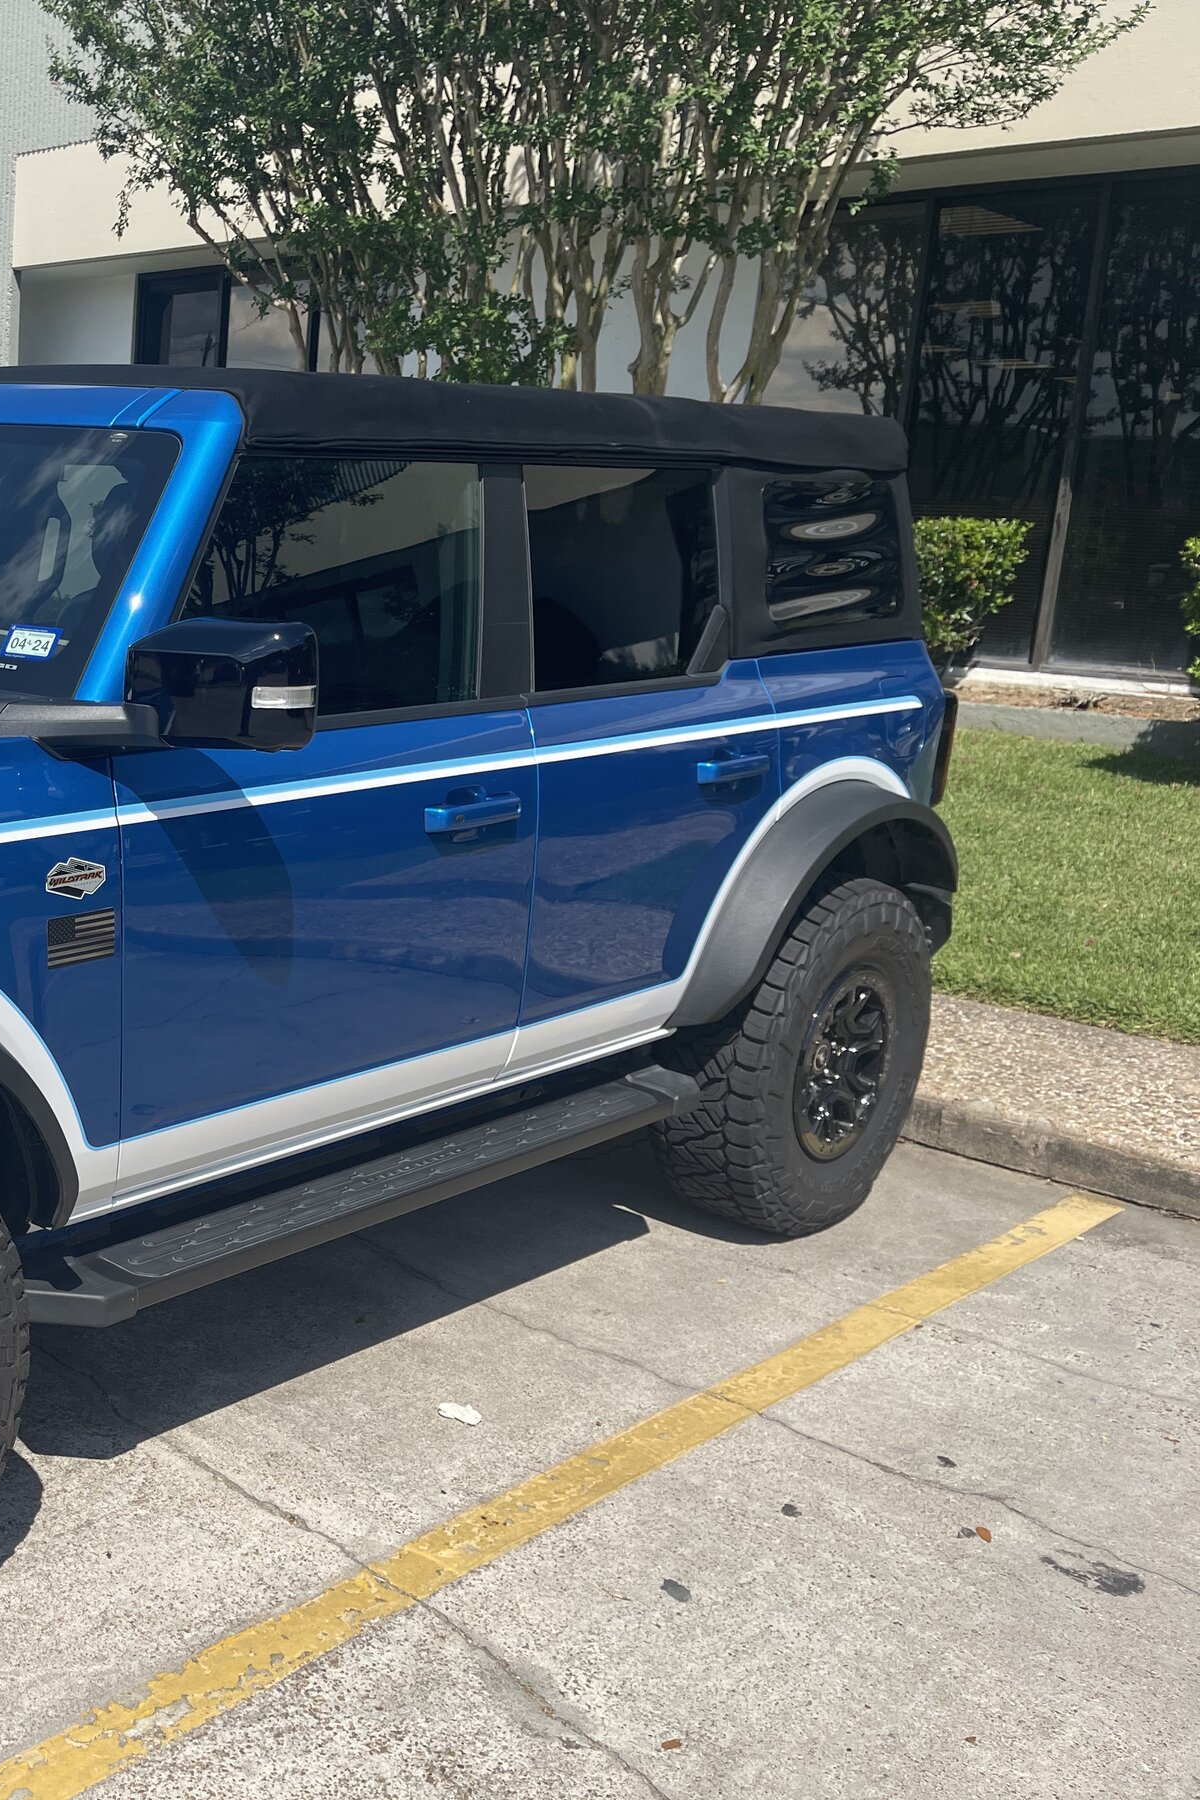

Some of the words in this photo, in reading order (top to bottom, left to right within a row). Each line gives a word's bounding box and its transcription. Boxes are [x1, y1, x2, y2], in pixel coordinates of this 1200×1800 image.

[10, 637, 28, 650] 04
[31, 639, 51, 652] 24
[48, 870, 104, 887] WILDTRAK
